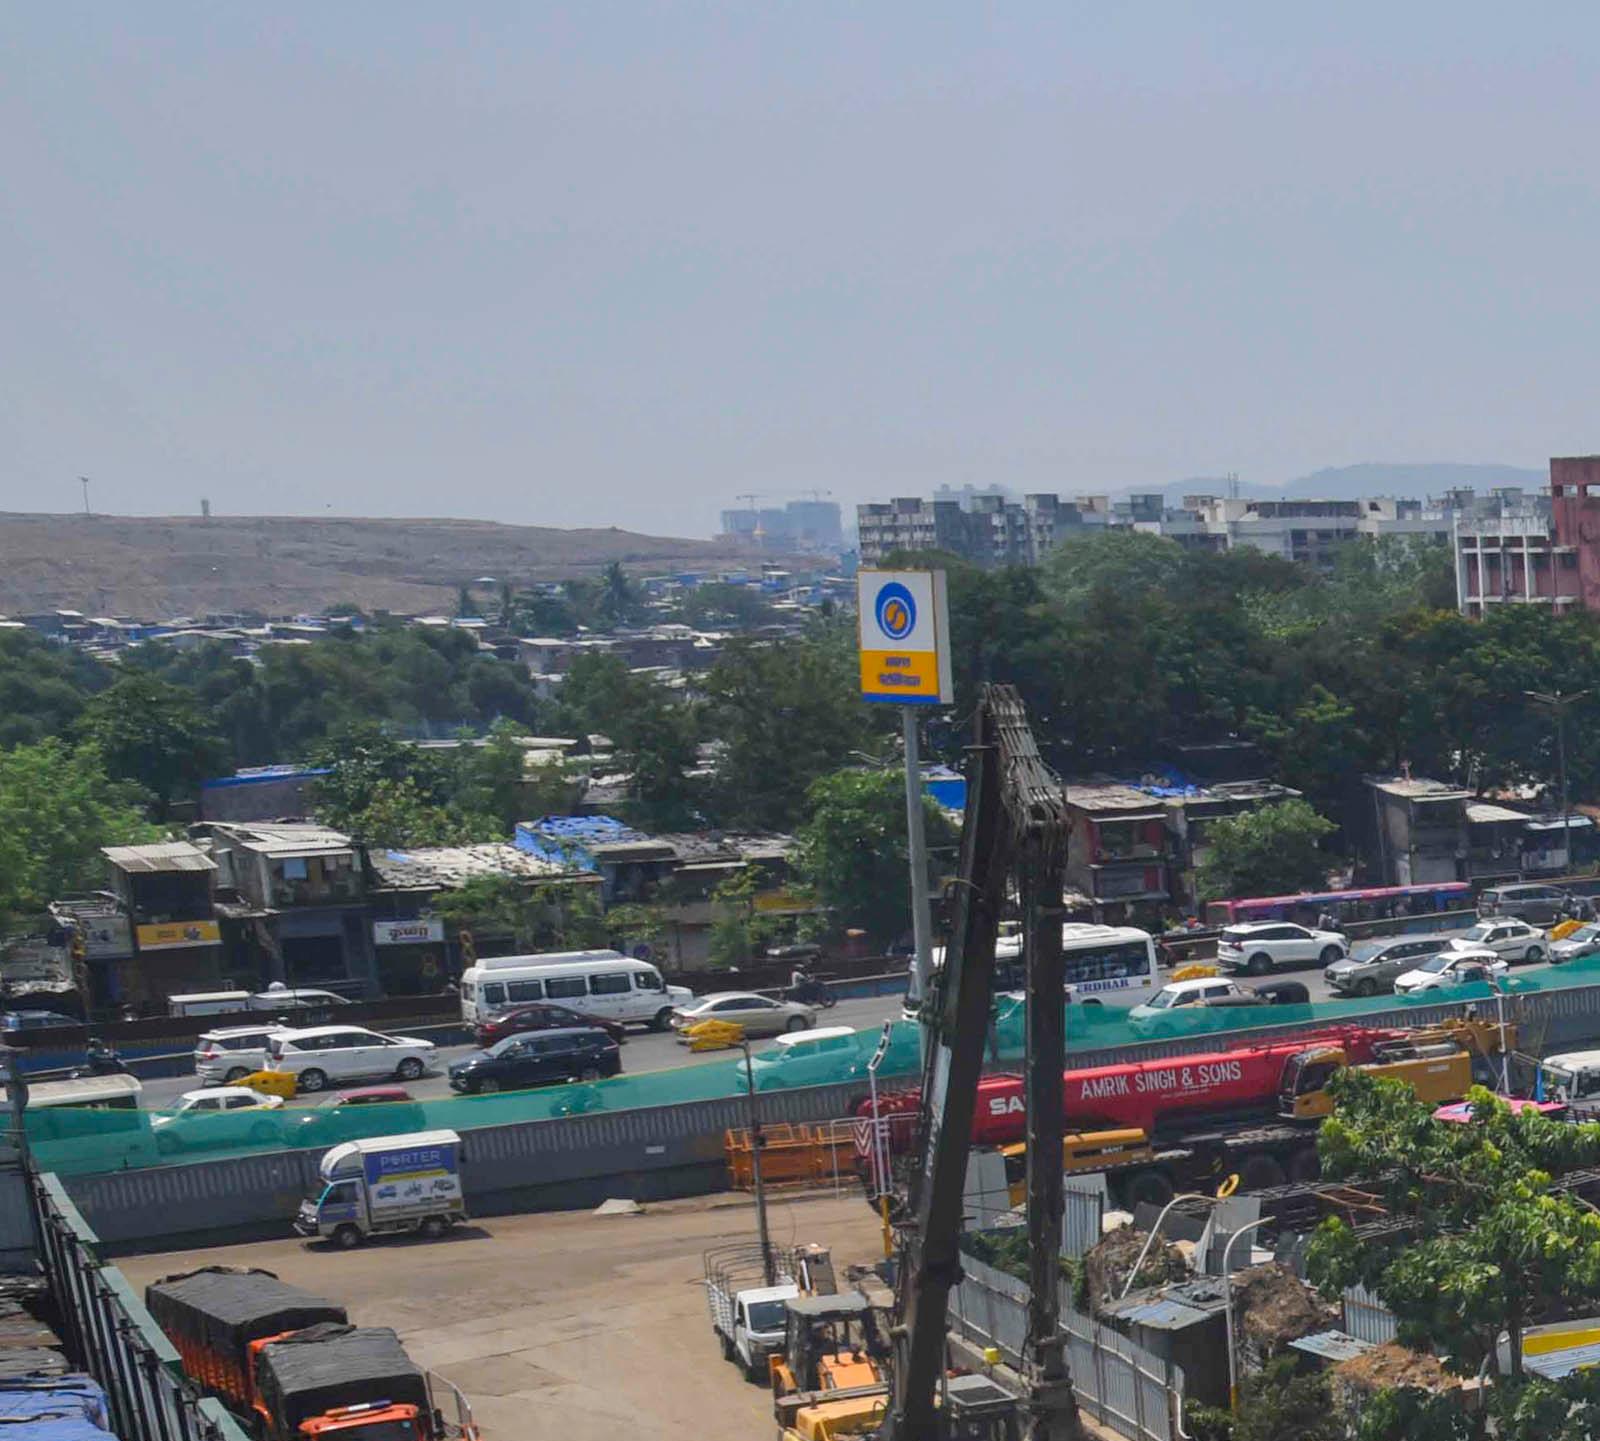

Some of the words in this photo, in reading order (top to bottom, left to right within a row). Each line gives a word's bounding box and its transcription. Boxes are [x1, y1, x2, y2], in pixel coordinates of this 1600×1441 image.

[1081, 1076, 1131, 1100] AMRIK
[1135, 1069, 1178, 1093] SINGH
[1181, 1068, 1194, 1086] &
[1198, 1061, 1242, 1084] SONS
[989, 1094, 1028, 1116] SA
[380, 1150, 441, 1167] PORTER
